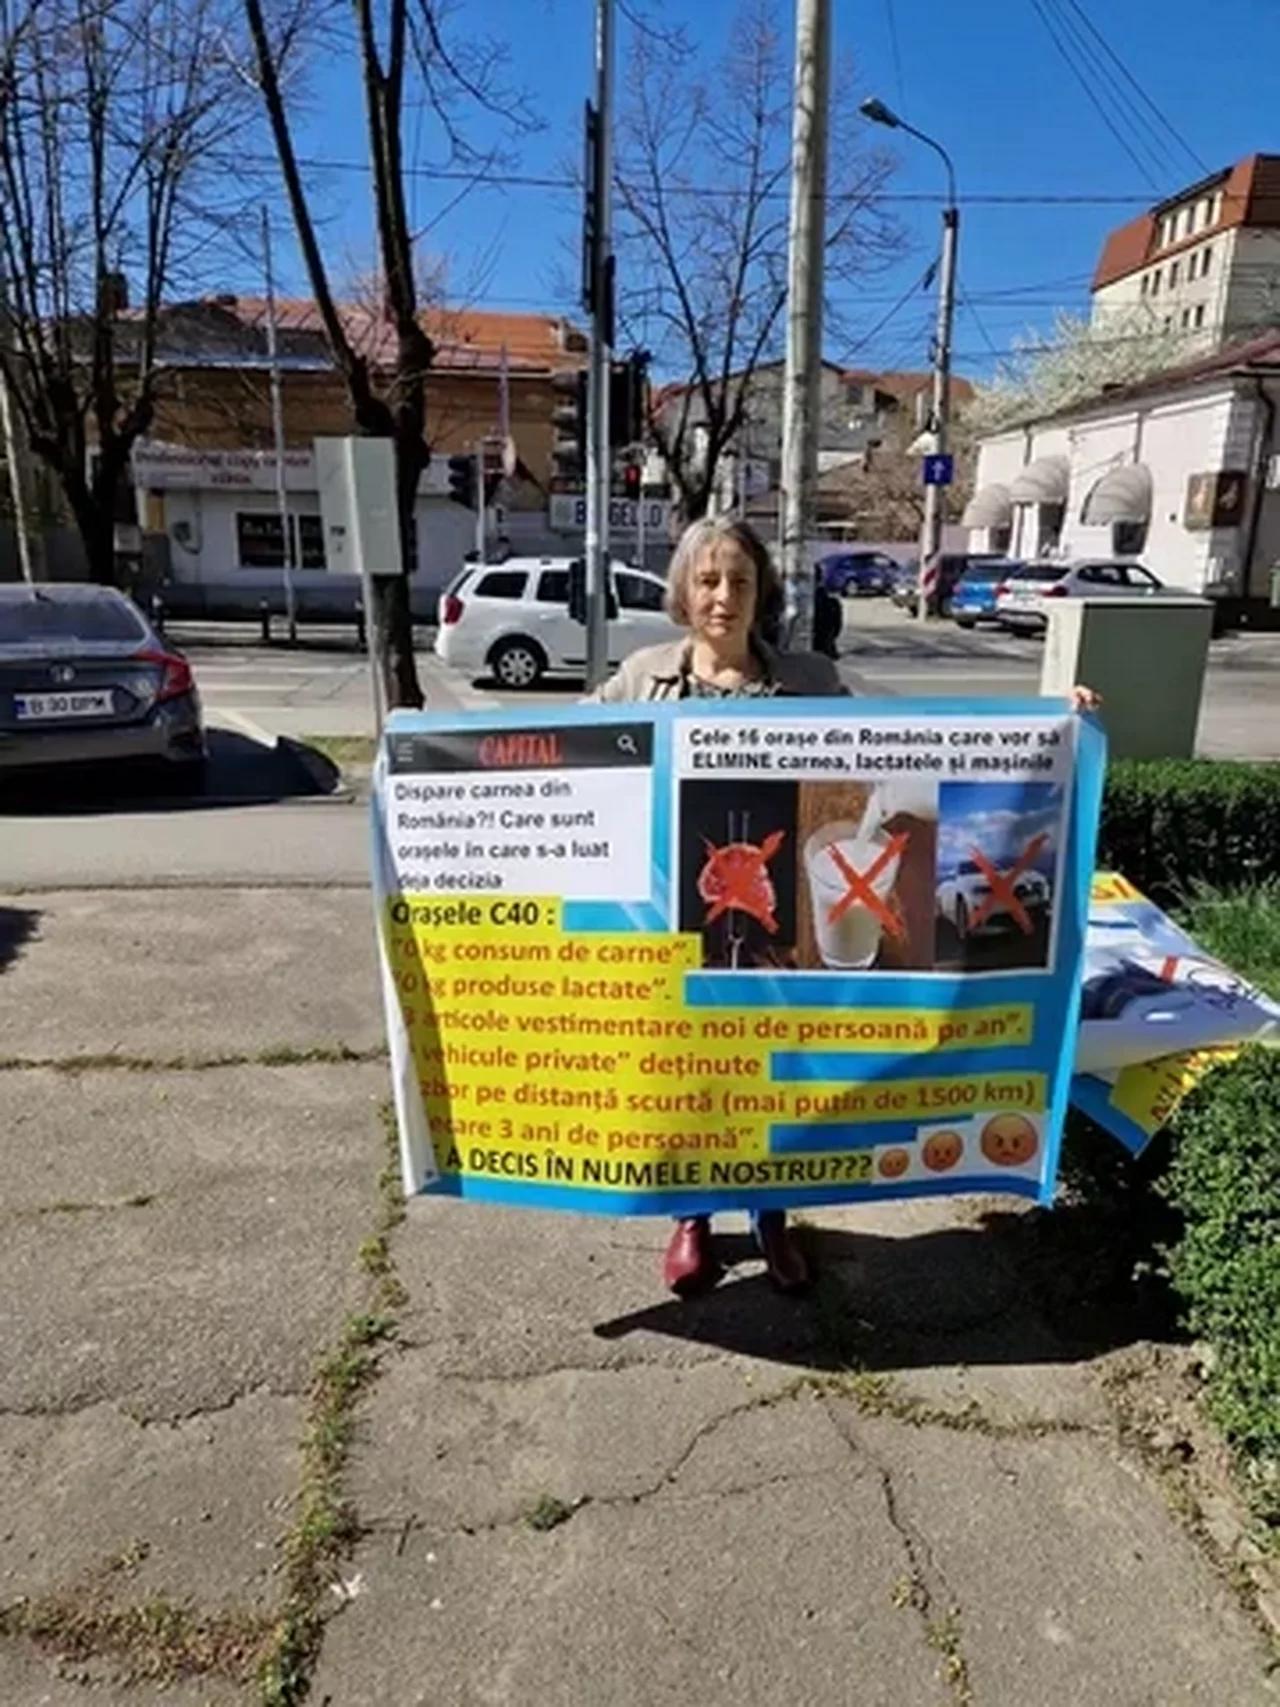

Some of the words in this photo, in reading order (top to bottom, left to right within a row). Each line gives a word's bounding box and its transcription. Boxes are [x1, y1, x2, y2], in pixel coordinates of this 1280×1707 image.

[689, 728, 731, 745] Cele
[738, 729, 759, 745] 16
[824, 728, 853, 745] din
[859, 728, 943, 746] România
[948, 731, 993, 746] care
[998, 732, 1031, 746] vor
[478, 735, 562, 766] CAPITAL
[693, 753, 772, 768] ELIMINE
[778, 756, 851, 771] carnea,
[856, 754, 943, 770] lactatele
[971, 754, 1054, 775] mașinile
[395, 784, 465, 801] Dispare
[470, 784, 534, 799] carnea
[540, 780, 571, 797] din
[500, 811, 545, 828] Care
[551, 810, 595, 827] sunt
[489, 844, 530, 857] care
[537, 843, 566, 857] s-a
[571, 841, 610, 857] luat
[434, 872, 502, 889] decizia
[391, 902, 482, 927] Orașele
[489, 902, 538, 925] C40
[423, 939, 447, 964] kg
[453, 944, 550, 961] consum
[557, 942, 591, 961] de
[453, 976, 556, 1000] produse
[422, 1008, 510, 1030] articole
[517, 1013, 692, 1038] vestimentare
[702, 1017, 746, 1039] noi
[754, 1018, 788, 1039] de
[798, 1018, 929, 1043] persoană
[938, 1022, 968, 1048] pe
[639, 1052, 761, 1078] deținute
[475, 1085, 507, 1106] pe
[627, 1089, 713, 1113] scurtă
[722, 1090, 786, 1117] (mai
[873, 1091, 907, 1110] de
[917, 1085, 977, 1107] 1500
[984, 1080, 1035, 1106] km)
[499, 1119, 514, 1139] 3
[520, 1122, 559, 1141] ani
[567, 1125, 599, 1146] de
[446, 1147, 463, 1168] A
[469, 1148, 538, 1176] DECIS
[545, 1150, 574, 1179] ÎN
[581, 1157, 702, 1185] NUMELE
[709, 1154, 872, 1184] NOSTRU???
